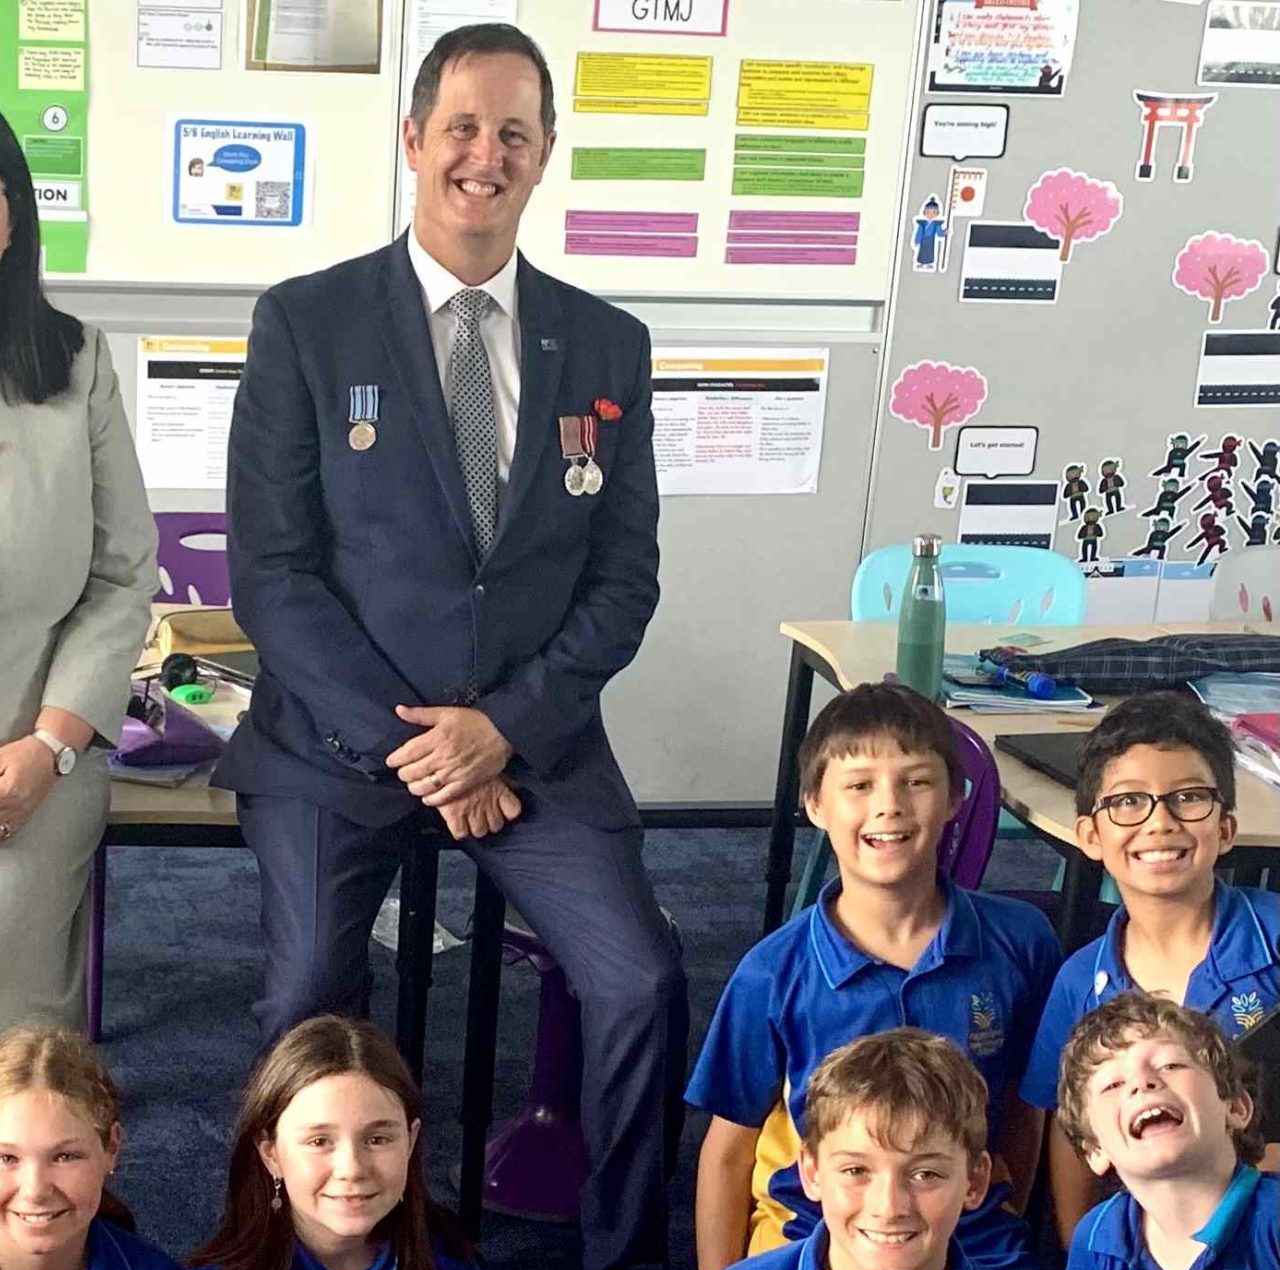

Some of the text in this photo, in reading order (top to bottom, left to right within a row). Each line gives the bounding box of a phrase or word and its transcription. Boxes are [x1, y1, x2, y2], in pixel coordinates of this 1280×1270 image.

[51, 111, 60, 124] 6
[183, 127, 293, 142] 5/6 English Learning Wall
